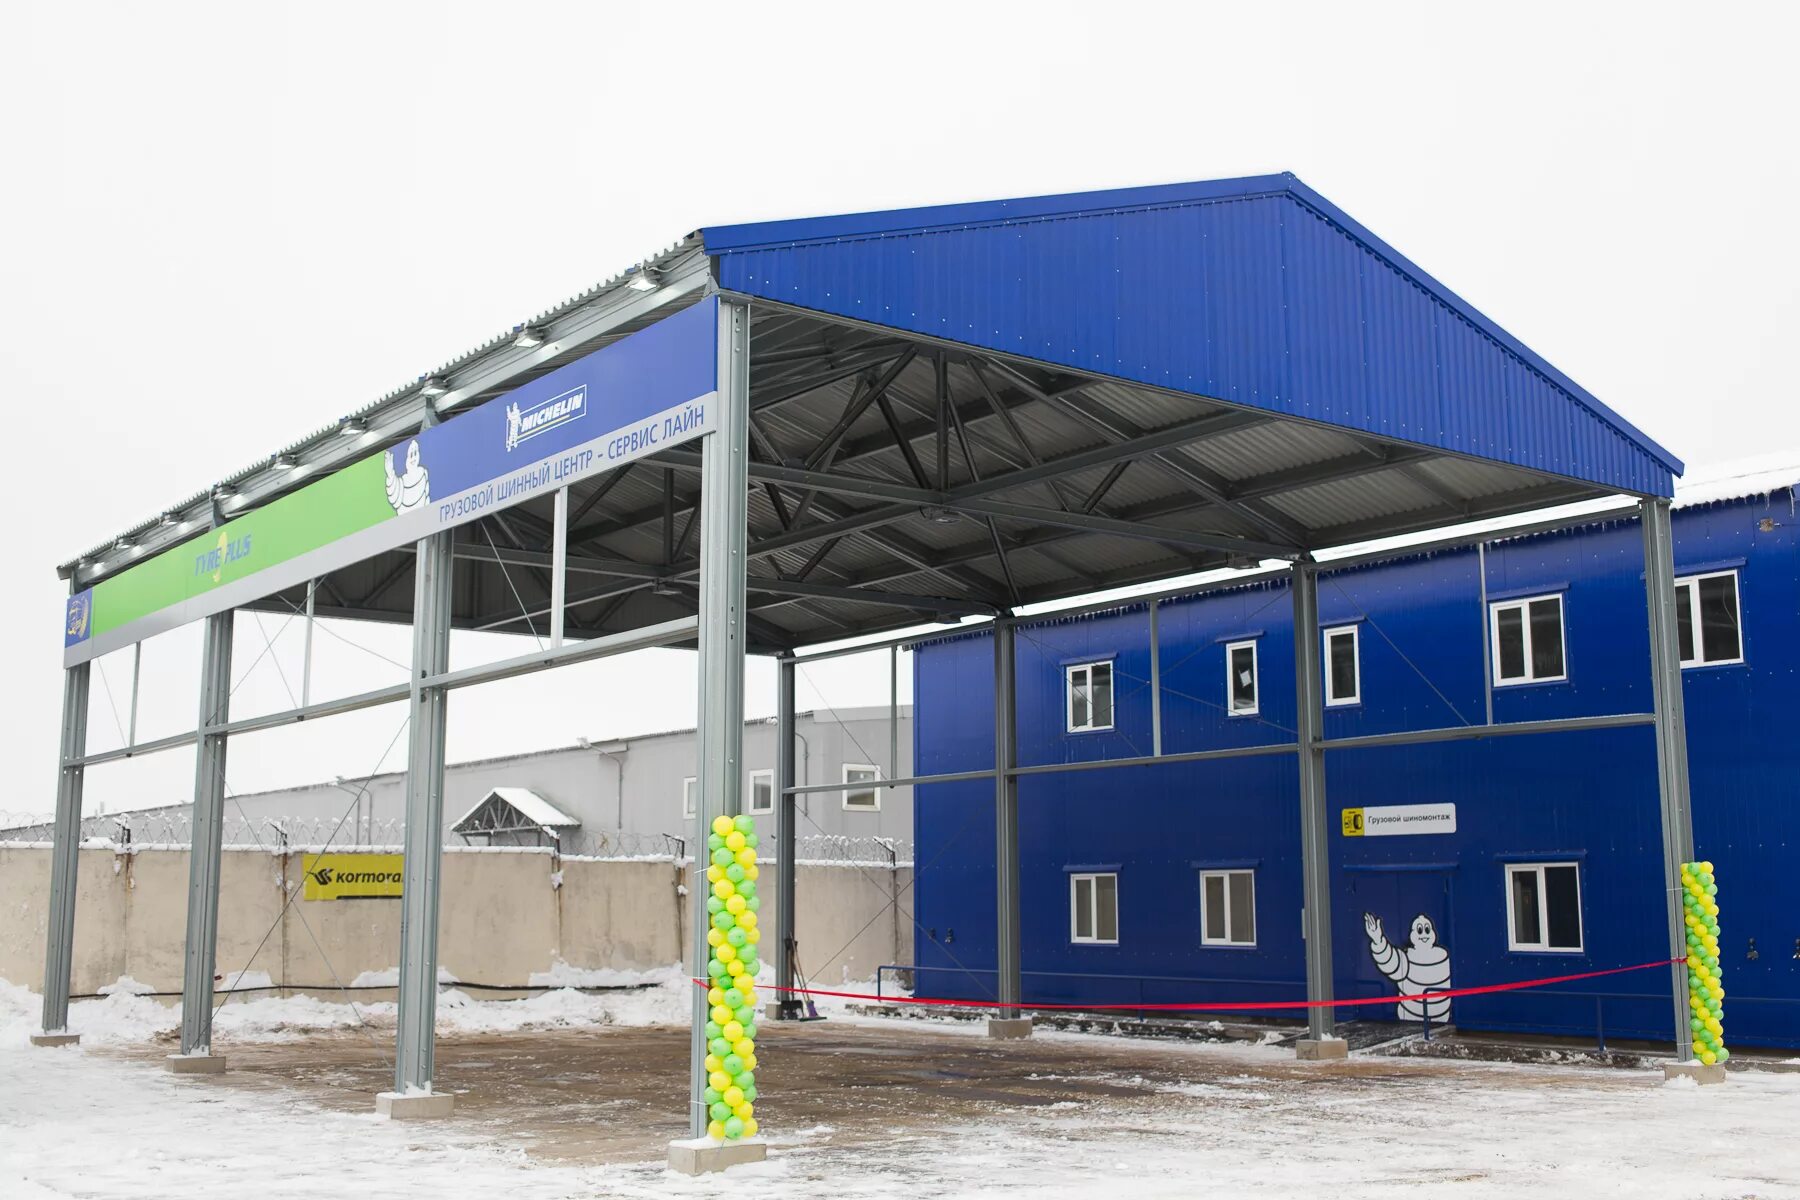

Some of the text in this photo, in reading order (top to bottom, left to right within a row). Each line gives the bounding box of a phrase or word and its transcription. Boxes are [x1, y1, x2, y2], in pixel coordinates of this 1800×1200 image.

[521, 392, 583, 433] MICHELIN
[439, 484, 493, 523] ГРУЗОВОЙ
[497, 462, 550, 501] ШИННЫЙ
[554, 449, 593, 482] ЦЕНТР
[608, 423, 658, 460] СЕРВИС
[662, 405, 704, 439] ЛАЙН
[194, 534, 252, 577] TYRE PLUS
[1368, 813, 1451, 825] Грузовой шиномонтаж
[336, 872, 403, 883] kormora
